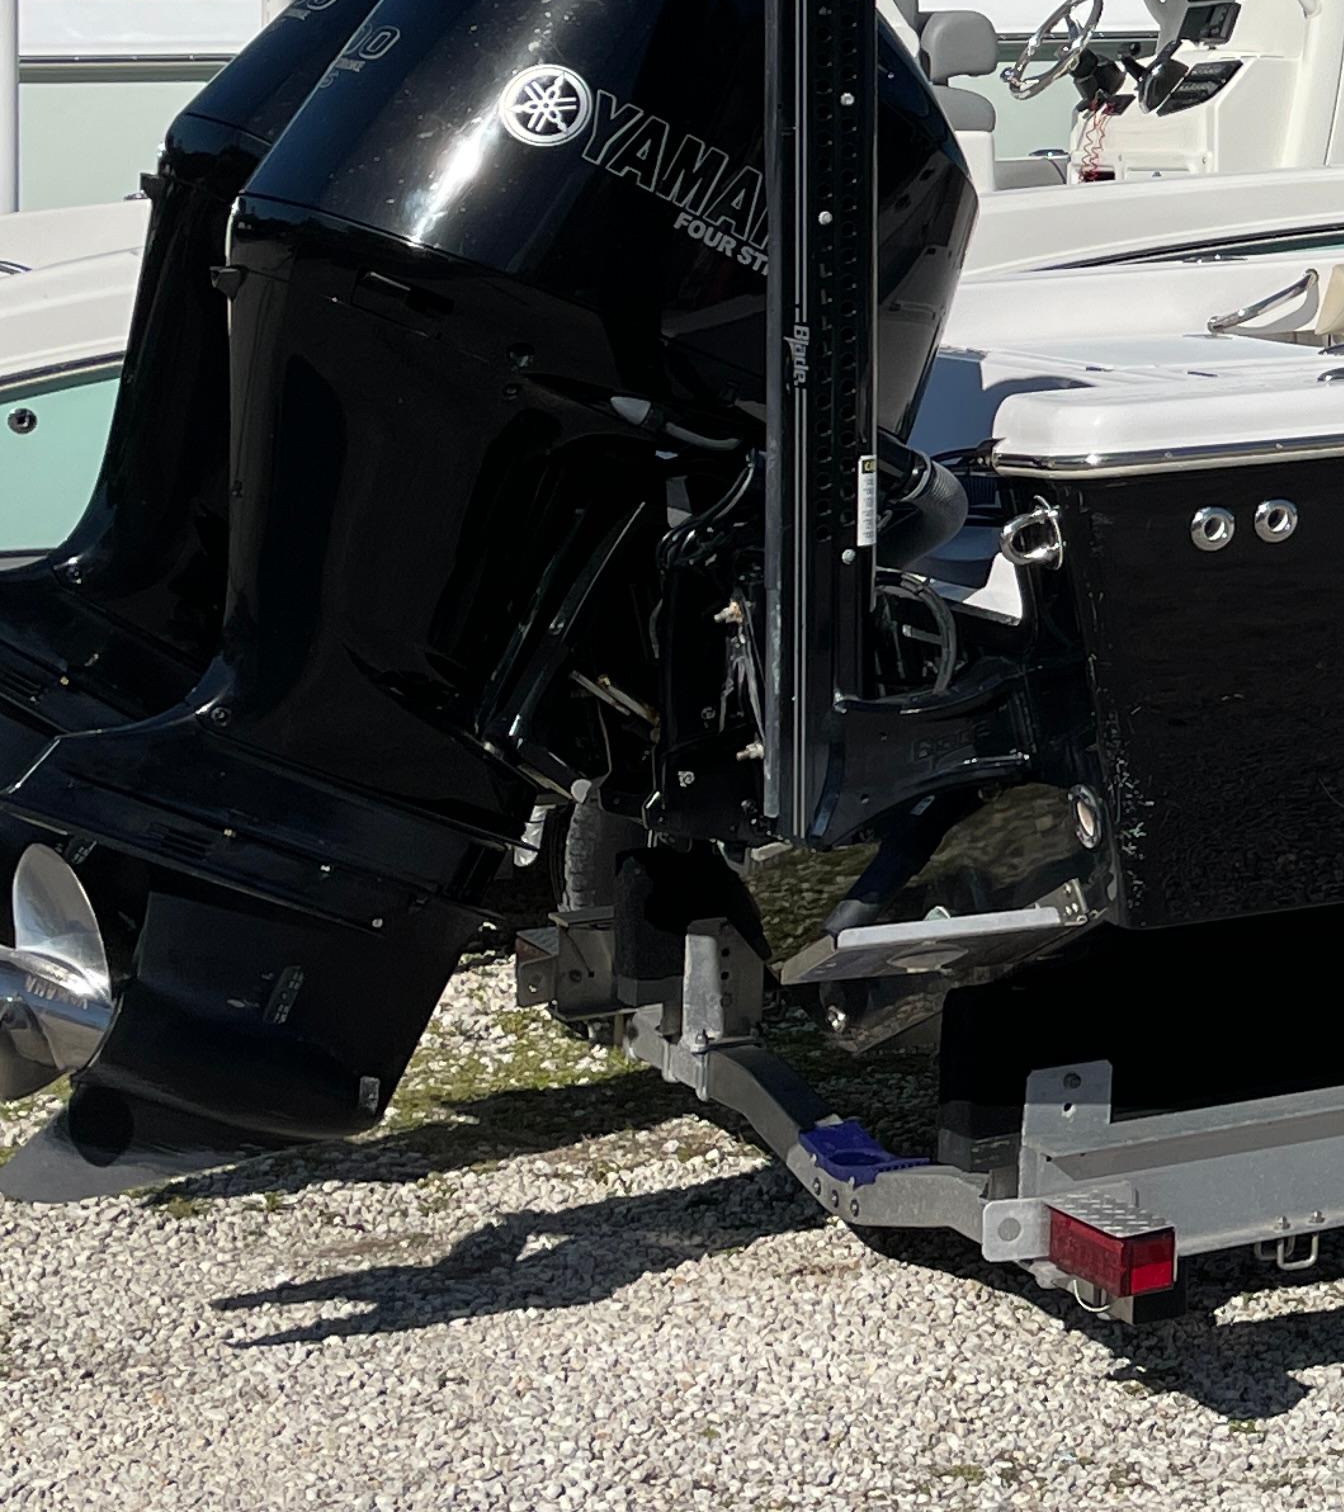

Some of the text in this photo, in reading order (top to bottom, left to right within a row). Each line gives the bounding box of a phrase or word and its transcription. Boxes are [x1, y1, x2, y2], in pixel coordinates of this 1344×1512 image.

[581, 88, 769, 250] YAMA
[673, 211, 769, 276] FOUR ST
